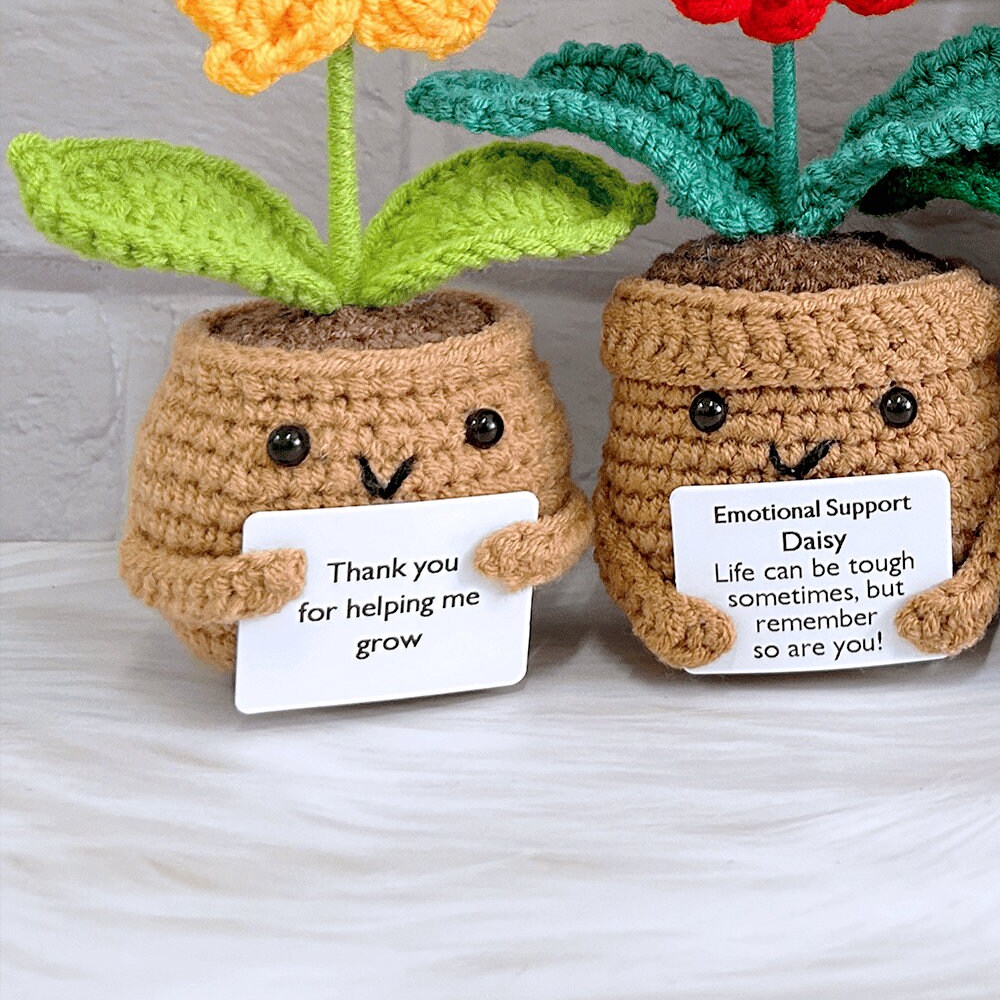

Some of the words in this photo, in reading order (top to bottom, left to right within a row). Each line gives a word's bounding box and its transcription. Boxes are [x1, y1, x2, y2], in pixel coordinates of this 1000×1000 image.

[714, 500, 821, 524] Emotional
[826, 496, 912, 519] Support
[783, 531, 847, 554] Daisy
[327, 557, 407, 583] Thank
[414, 557, 459, 582] you
[715, 563, 755, 583] Life
[764, 566, 803, 580] can
[812, 558, 840, 577] be
[849, 551, 915, 577] tough
[299, 602, 338, 623] for
[346, 595, 436, 621] helping
[442, 591, 480, 609] me
[728, 586, 860, 608] sometimes,
[867, 580, 905, 599] but
[756, 609, 878, 633] remember
[355, 633, 423, 660] grow
[753, 645, 780, 659] so
[788, 642, 825, 657] are
[833, 632, 883, 661] you!
